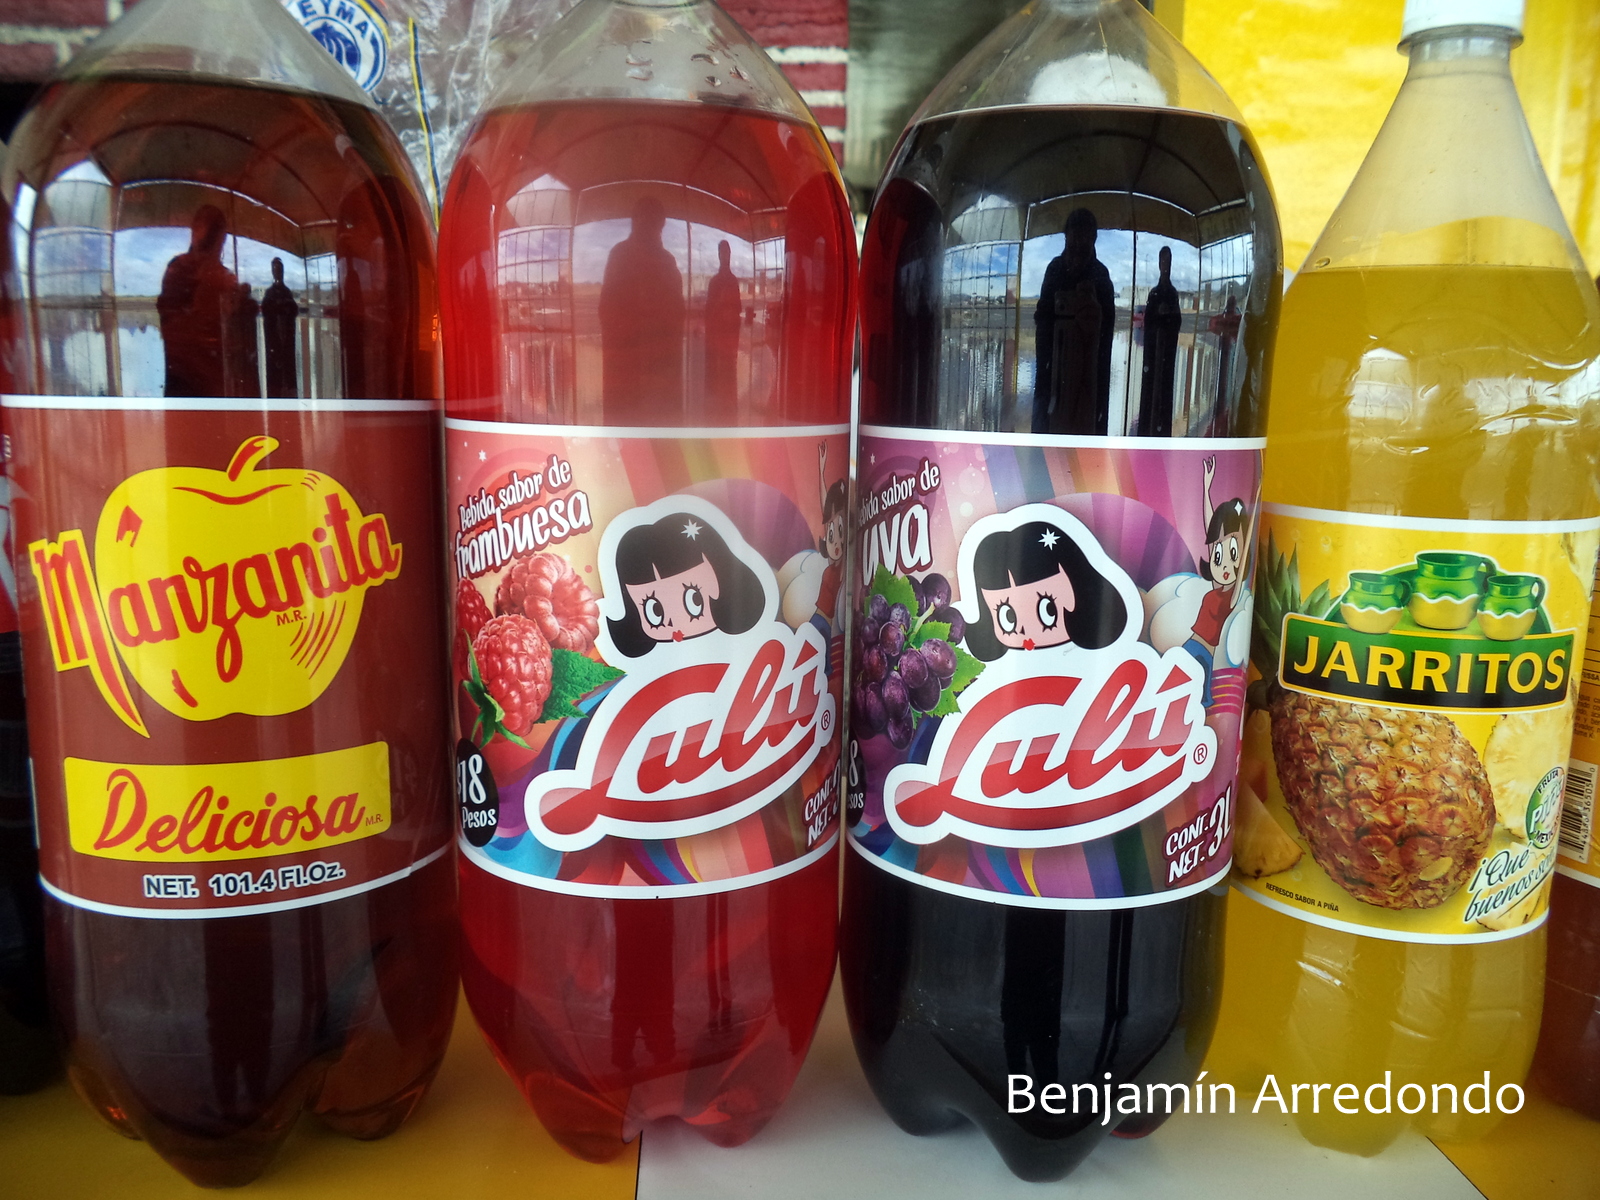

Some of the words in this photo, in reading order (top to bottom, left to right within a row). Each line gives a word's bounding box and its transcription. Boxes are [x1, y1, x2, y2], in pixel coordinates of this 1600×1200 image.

[460, 489, 495, 532] Bebida
[498, 472, 543, 510] sabor
[548, 456, 571, 488] de
[881, 475, 915, 511] sabor
[921, 460, 940, 491] de
[455, 491, 592, 579] frambuesa
[863, 504, 931, 586] uva
[34, 494, 400, 727] Manzanita
[276, 609, 307, 626] M.R.
[1294, 635, 1565, 695] JARRITOS
[93, 768, 366, 855] Deliciosa
[462, 806, 497, 829] Pesos
[1166, 812, 1208, 856] CONT.
[146, 876, 197, 896] NET.
[211, 871, 274, 896] 101.4
[1168, 841, 1205, 883] NET.
[1469, 841, 1533, 892] ¡Qué
[1265, 882, 1294, 899] REFRESCO
[1294, 893, 1316, 906] SABOR
[1317, 900, 1322, 908] A
[1323, 902, 1339, 912] PIÑA
[1464, 874, 1534, 922] buenos
